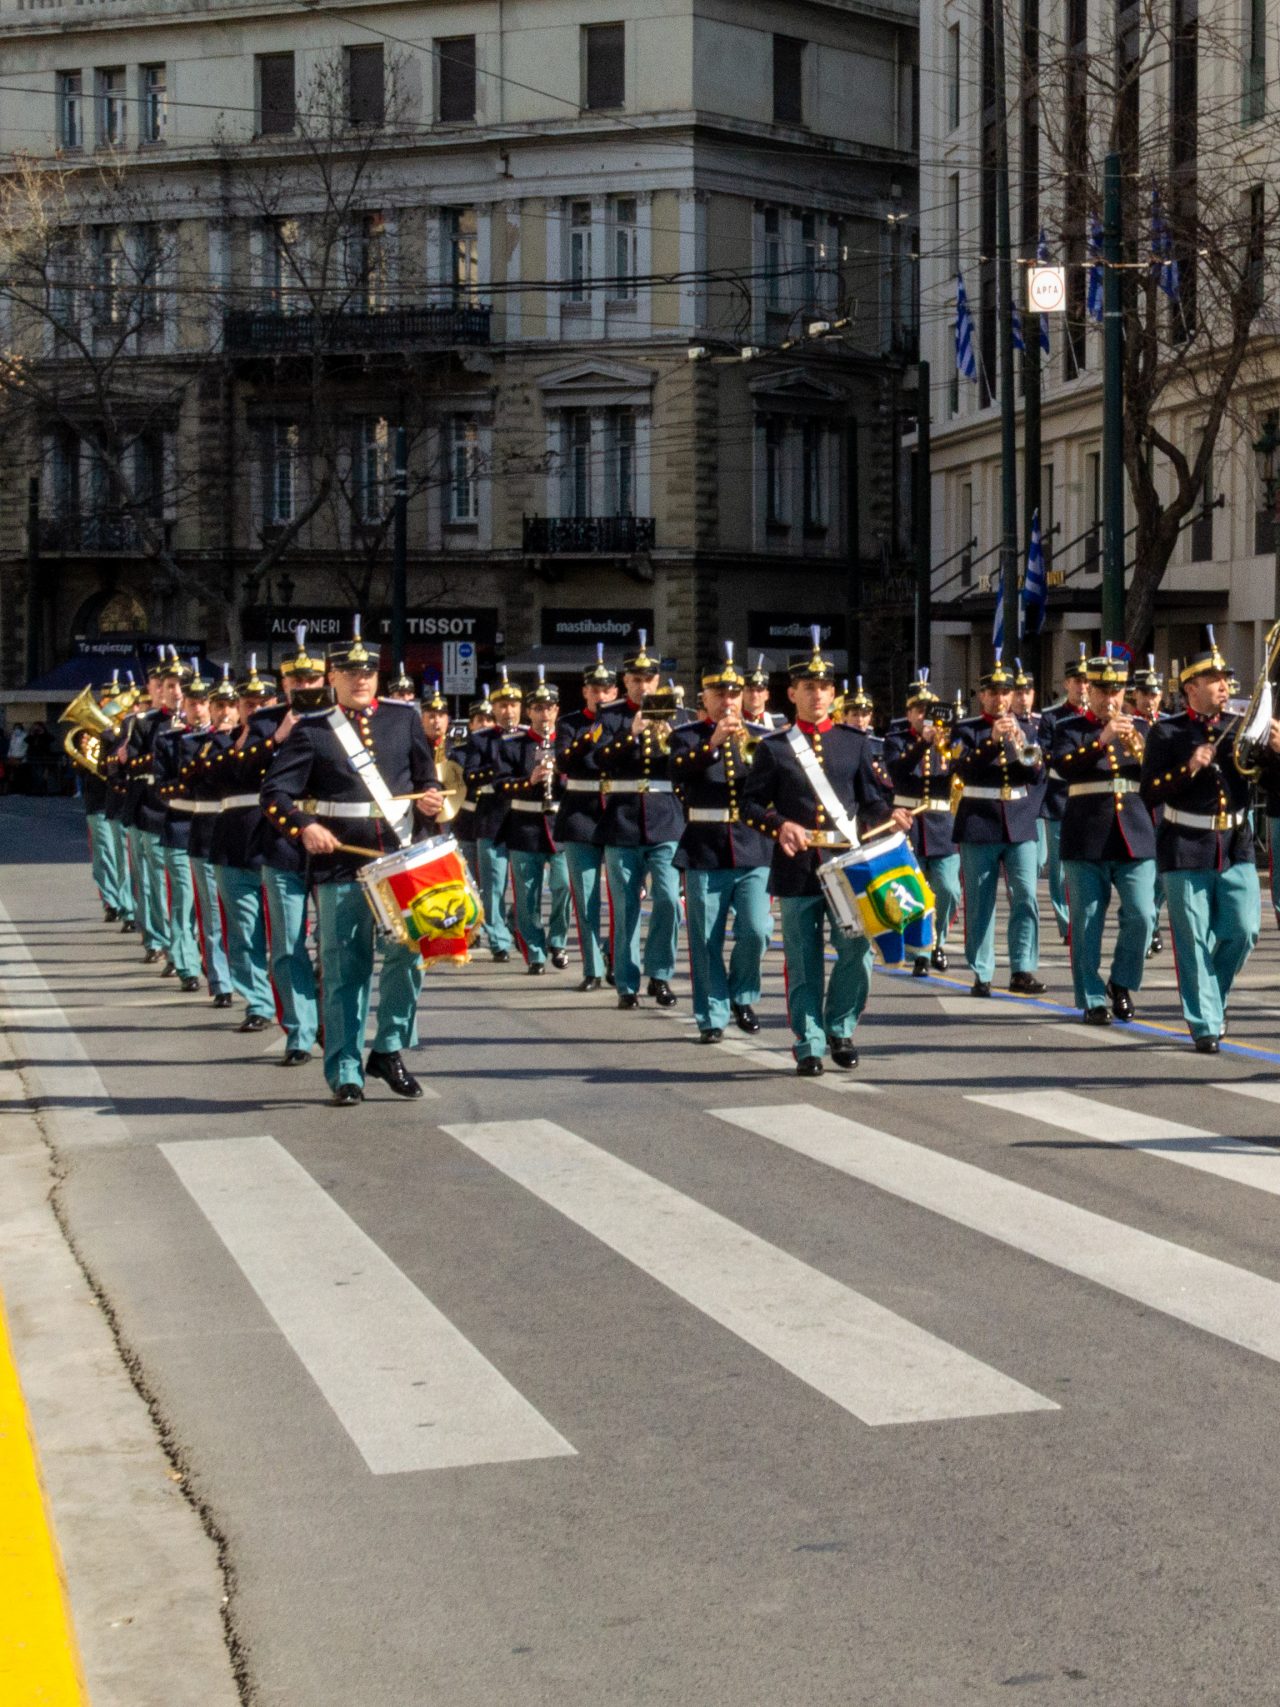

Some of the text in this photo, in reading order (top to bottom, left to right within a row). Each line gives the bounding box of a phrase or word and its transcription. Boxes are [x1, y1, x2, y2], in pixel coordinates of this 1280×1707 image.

[1036, 285, 1059, 295] ΑΡΓΑ
[406, 618, 476, 635] TISSOT
[556, 619, 632, 636] mastihashop
